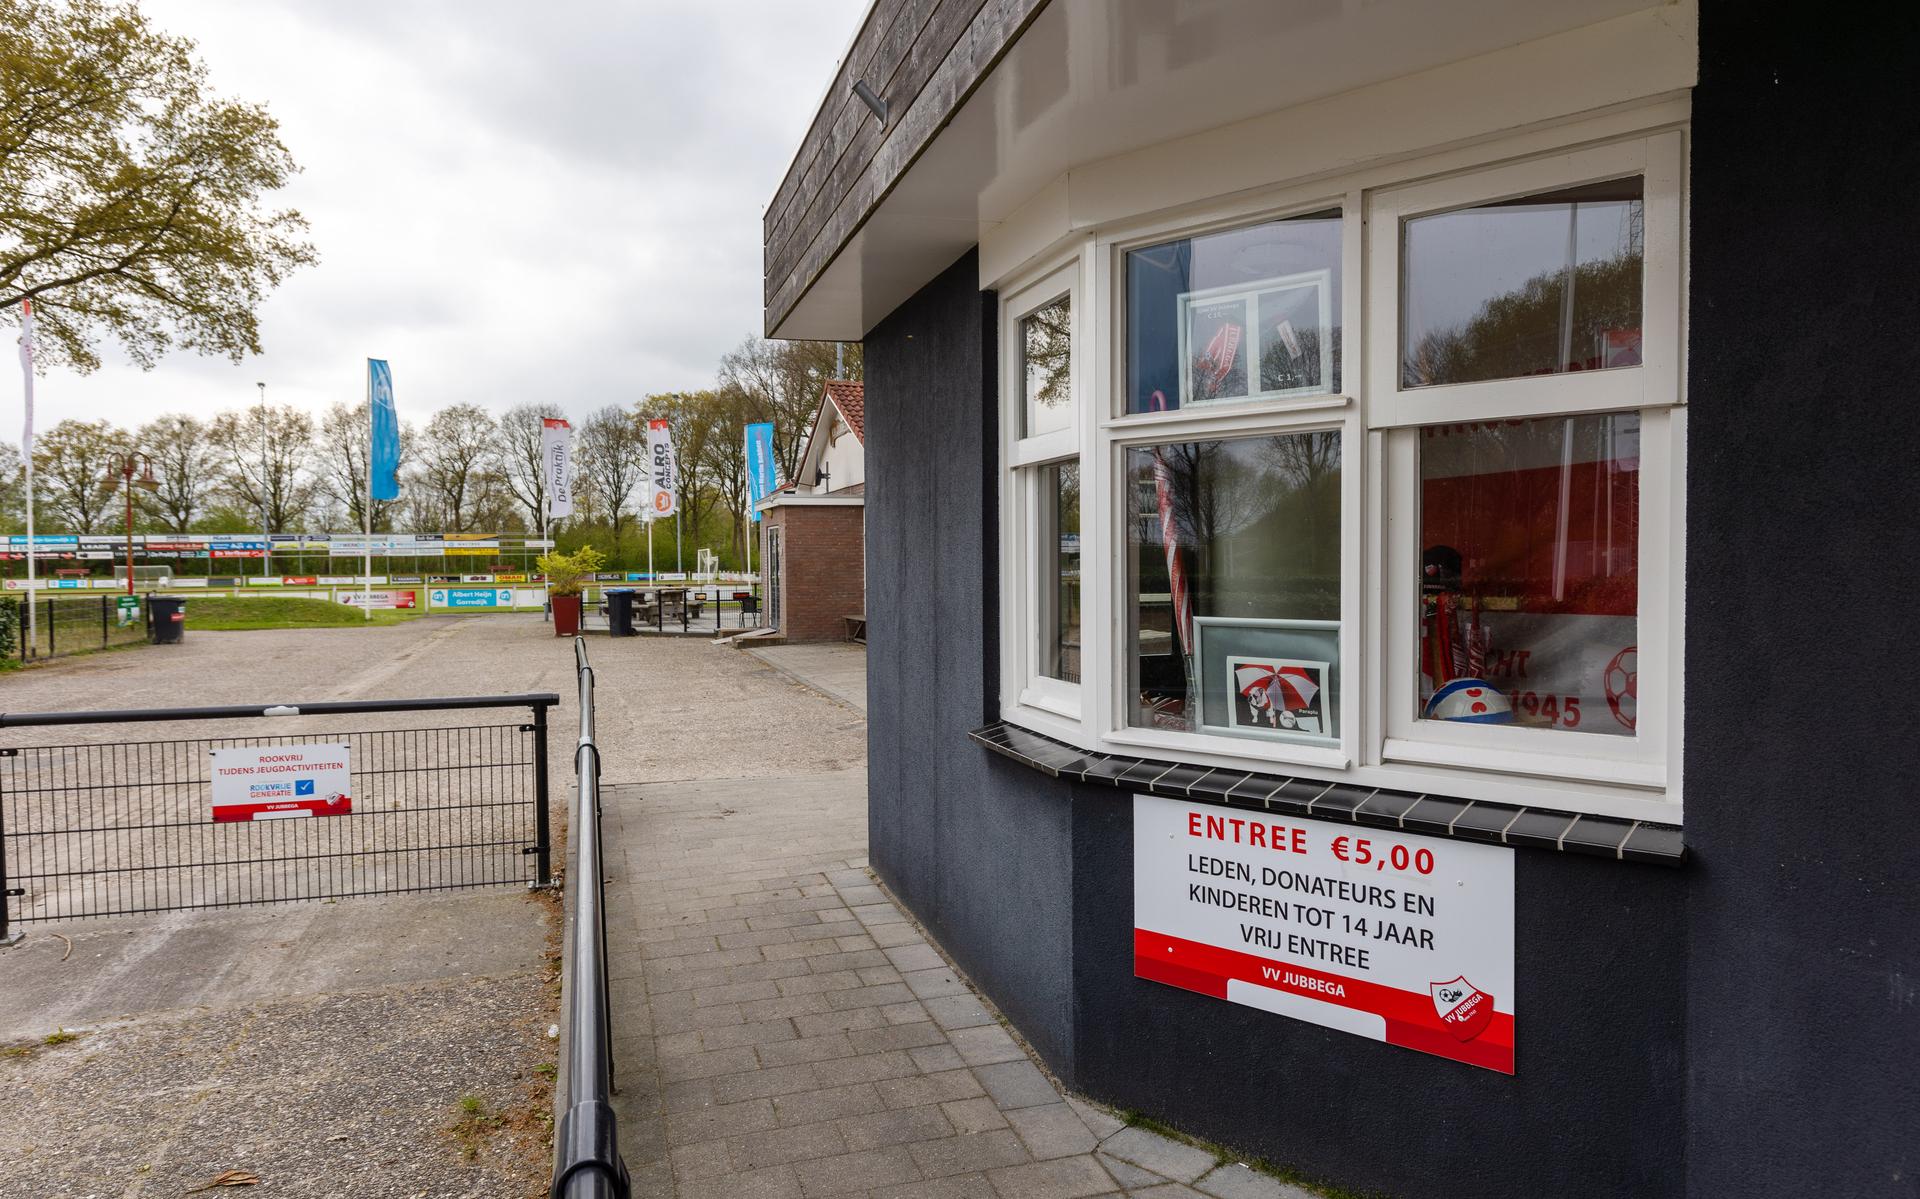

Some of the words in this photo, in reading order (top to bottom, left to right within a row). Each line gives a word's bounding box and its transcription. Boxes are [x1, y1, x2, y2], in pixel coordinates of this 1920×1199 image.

[654, 443, 666, 489] ALRO
[476, 591, 493, 599] Heijn
[1510, 690, 1581, 728] 1945
[218, 767, 255, 776] TIJDENS
[256, 762, 344, 774] JEUGDACTIVITEITEN
[259, 754, 304, 763] ROOKVRIJ
[250, 783, 292, 791] ROOKVRIJE
[250, 789, 292, 798] GENERATIE
[1188, 812, 1308, 855] ENTREE
[1331, 835, 1436, 875] €5,00
[1188, 854, 1257, 886] LEDEN,
[1262, 867, 1397, 910] DONATEURS
[1403, 895, 1436, 918] EN
[1189, 883, 1289, 921] KINDEREN
[1293, 903, 1333, 930] TOT
[1342, 914, 1369, 938] 14
[1373, 920, 1435, 951] JAAR
[1240, 923, 1282, 950] VRIJ
[1288, 936, 1370, 970] ENTREE
[1262, 965, 1281, 981] VV
[1282, 970, 1346, 998] JUBBEGA
[1445, 1012, 1456, 1024] VV
[1455, 993, 1484, 1016] JUBBEGA
